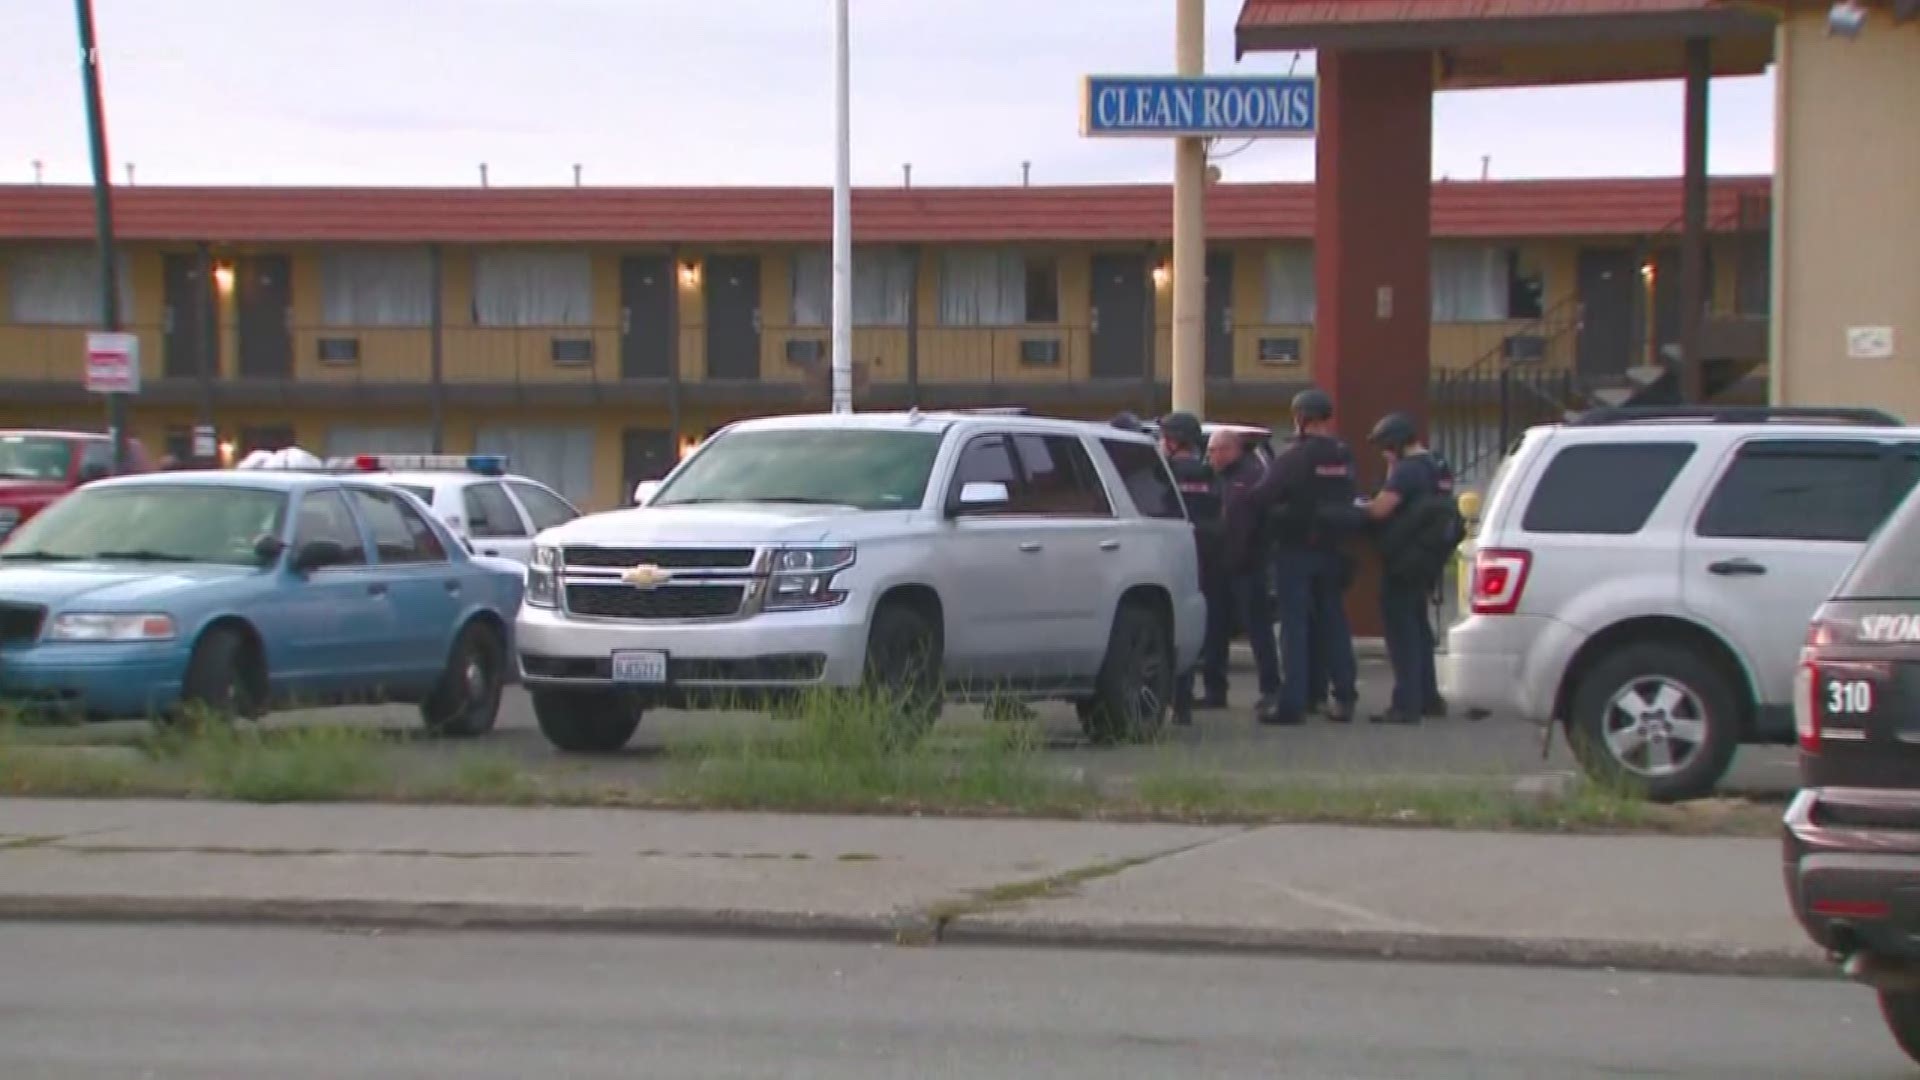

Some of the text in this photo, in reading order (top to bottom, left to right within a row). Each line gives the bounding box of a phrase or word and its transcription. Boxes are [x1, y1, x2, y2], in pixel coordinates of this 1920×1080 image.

[1098, 86, 1310, 128] CLEAN ROOMS
[1827, 680, 1871, 714] 310
